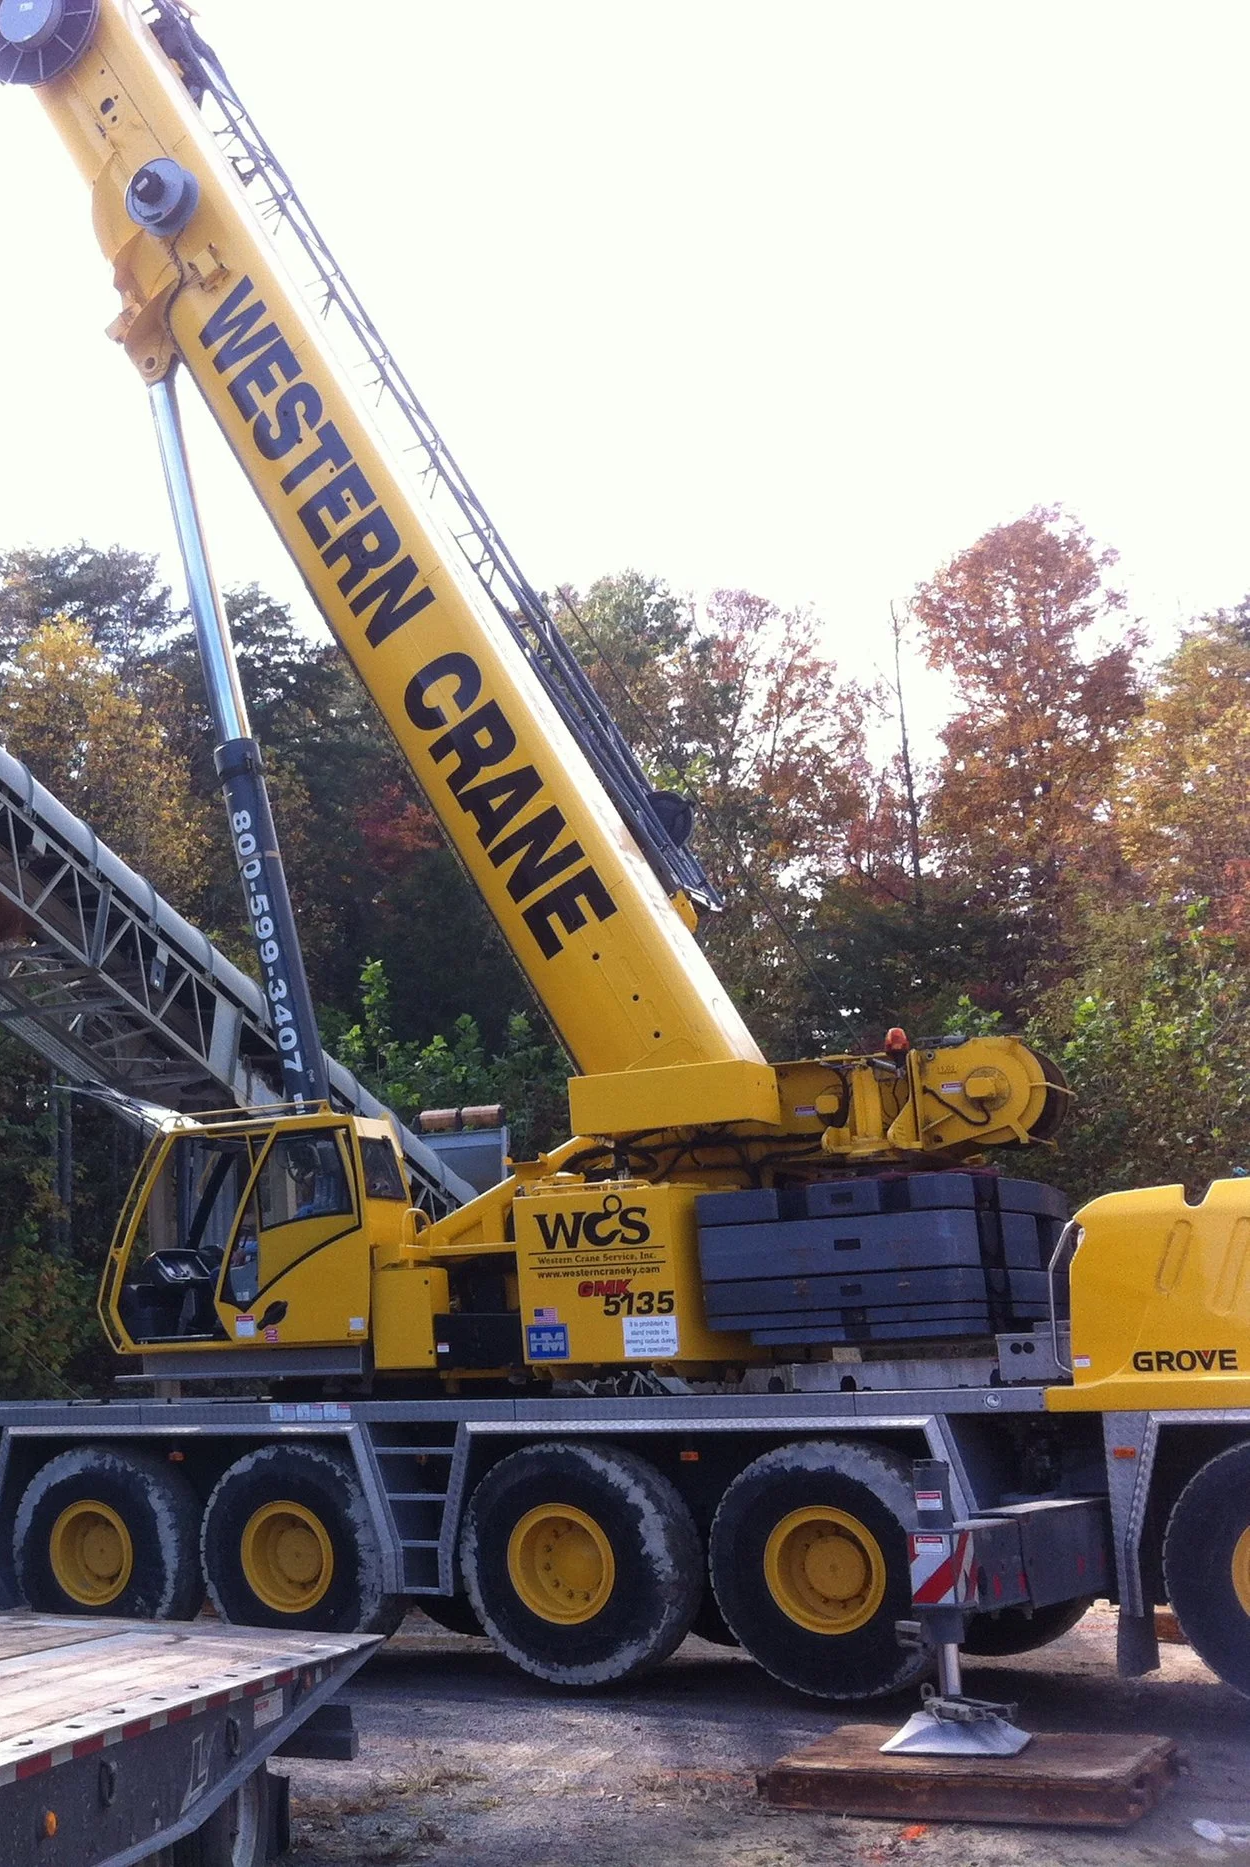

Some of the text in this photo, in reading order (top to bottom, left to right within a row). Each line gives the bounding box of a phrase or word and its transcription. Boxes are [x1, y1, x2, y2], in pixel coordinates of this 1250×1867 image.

[198, 275, 618, 961] WESTERN CRANE
[232, 809, 303, 1073] 800-599-3407
[533, 1194, 650, 1250] WCS
[538, 1251, 657, 1265] Western Crane Service, Inc.
[578, 1278, 633, 1297] GMK
[603, 1290, 674, 1316] 5135
[1132, 1349, 1238, 1372] GROVE
